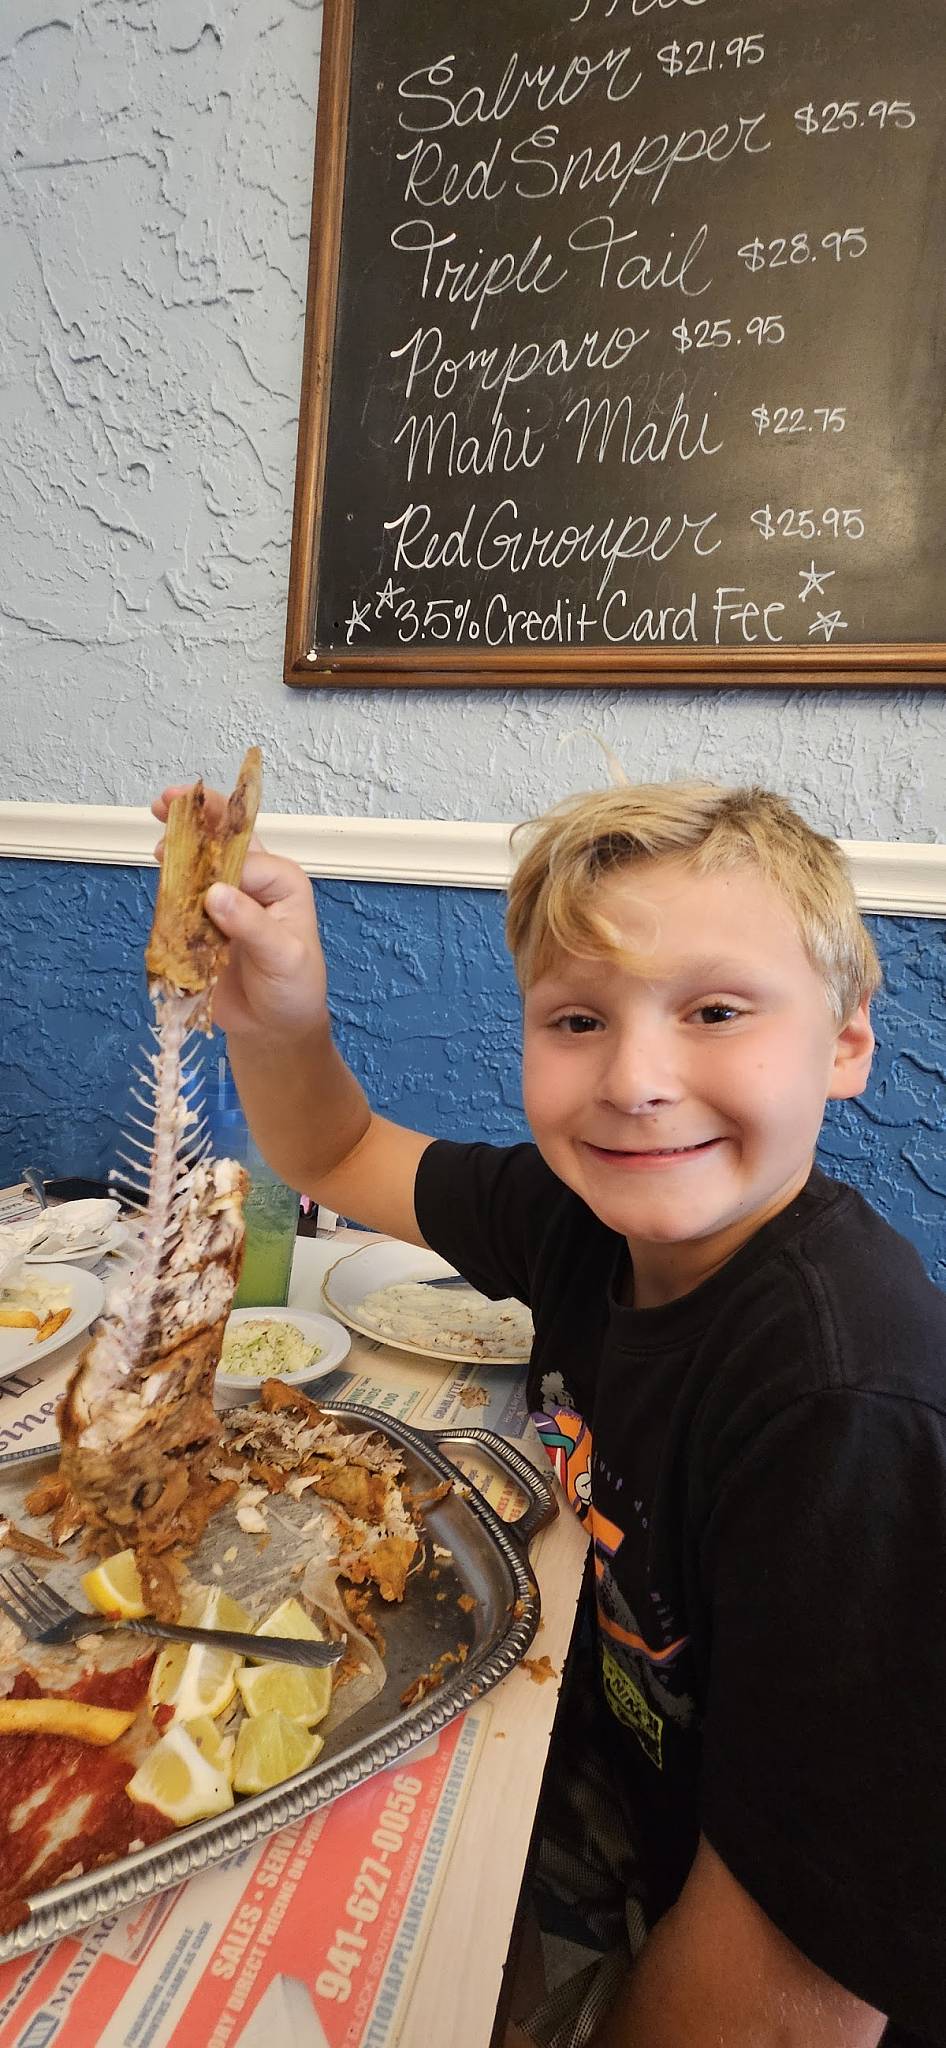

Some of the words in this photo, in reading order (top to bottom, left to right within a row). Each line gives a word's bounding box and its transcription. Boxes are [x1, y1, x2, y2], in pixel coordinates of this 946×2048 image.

[656, 34, 766, 79] $21.95
[396, 137, 507, 207] Red
[510, 113, 772, 208] Snapper
[794, 101, 917, 136] $25.95
[391, 218, 568, 332] Triple
[568, 215, 713, 298] Tail
[737, 227, 868, 274] $28.95
[671, 314, 786, 352] $25.95
[394, 408, 546, 483] Mahi
[565, 391, 725, 467] Mahi
[751, 403, 847, 436] $22.75
[384, 503, 484, 573] Red
[479, 500, 724, 600] Grouper
[751, 508, 867, 541] $25.95
[397, 598, 481, 643] 3.5%
[484, 594, 598, 647] Credit
[602, 590, 699, 643] Card
[712, 587, 786, 645] Fee
[314, 1773, 423, 2005] 941-627-0056
[362, 1717, 481, 2048] TIONAPPLIANCESALESANDSERVICE.COM
[50, 1916, 119, 2010] MAYTAG
[210, 1903, 263, 1981] SALES
[226, 1946, 267, 2012] DIRECT
[256, 1880, 298, 1946] PRICING
[287, 1856, 308, 1881] ON
